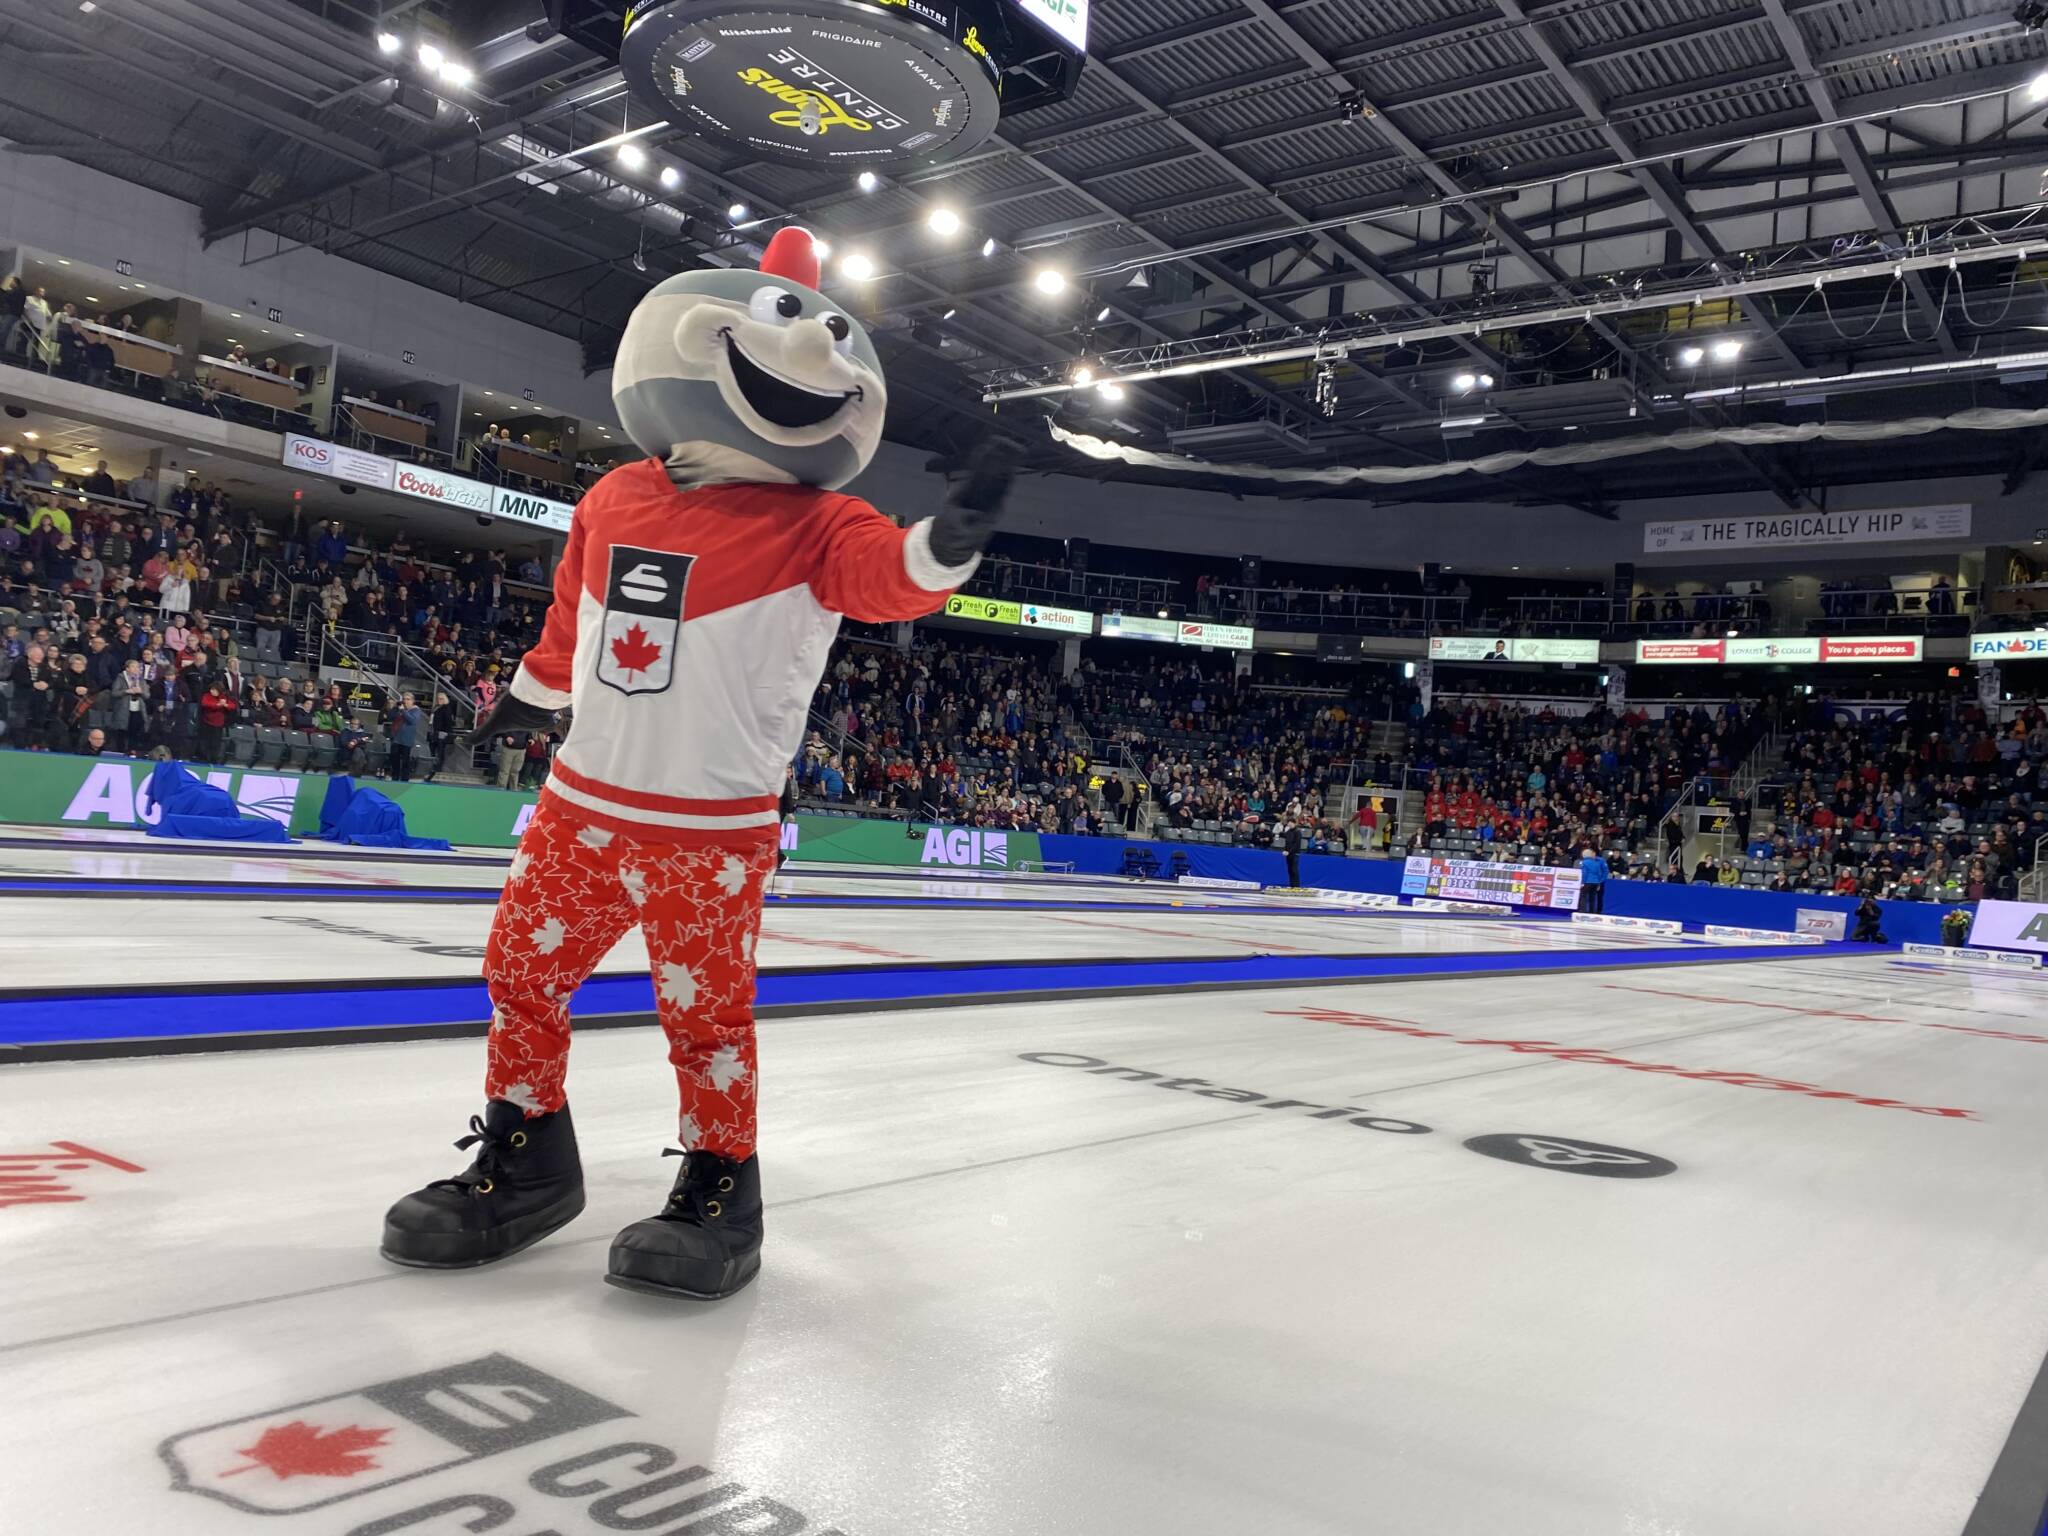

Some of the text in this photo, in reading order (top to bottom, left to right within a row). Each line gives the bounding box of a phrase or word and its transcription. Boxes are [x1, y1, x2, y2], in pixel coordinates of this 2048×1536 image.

[719, 27, 793, 37] KitchenAid
[811, 30, 882, 48] FRIGIDAIRE
[681, 40, 711, 59] MAYTAG
[904, 58, 944, 90] AMANA
[767, 48, 902, 130] CENTRE
[748, 136, 809, 153] FRIGIDAIRE
[116, 262, 131, 275] 410
[269, 309, 281, 322] 411
[402, 351, 415, 364] 412
[295, 443, 328, 461] KOS
[399, 471, 445, 499] Coors
[444, 486, 489, 508] LIGHT
[500, 494, 548, 520] MNP
[1650, 526, 1675, 536] HOME
[1702, 513, 1903, 540] THE TRAGICALLY HIP
[1656, 538, 1667, 547] OF
[1041, 611, 1073, 624] action
[1732, 646, 1812, 655] LOYALIST COLLEGE
[1854, 646, 1876, 656] going
[921, 828, 981, 866] AGI
[1807, 918, 1834, 928] TSN
[1018, 1051, 1434, 1135] Ontario
